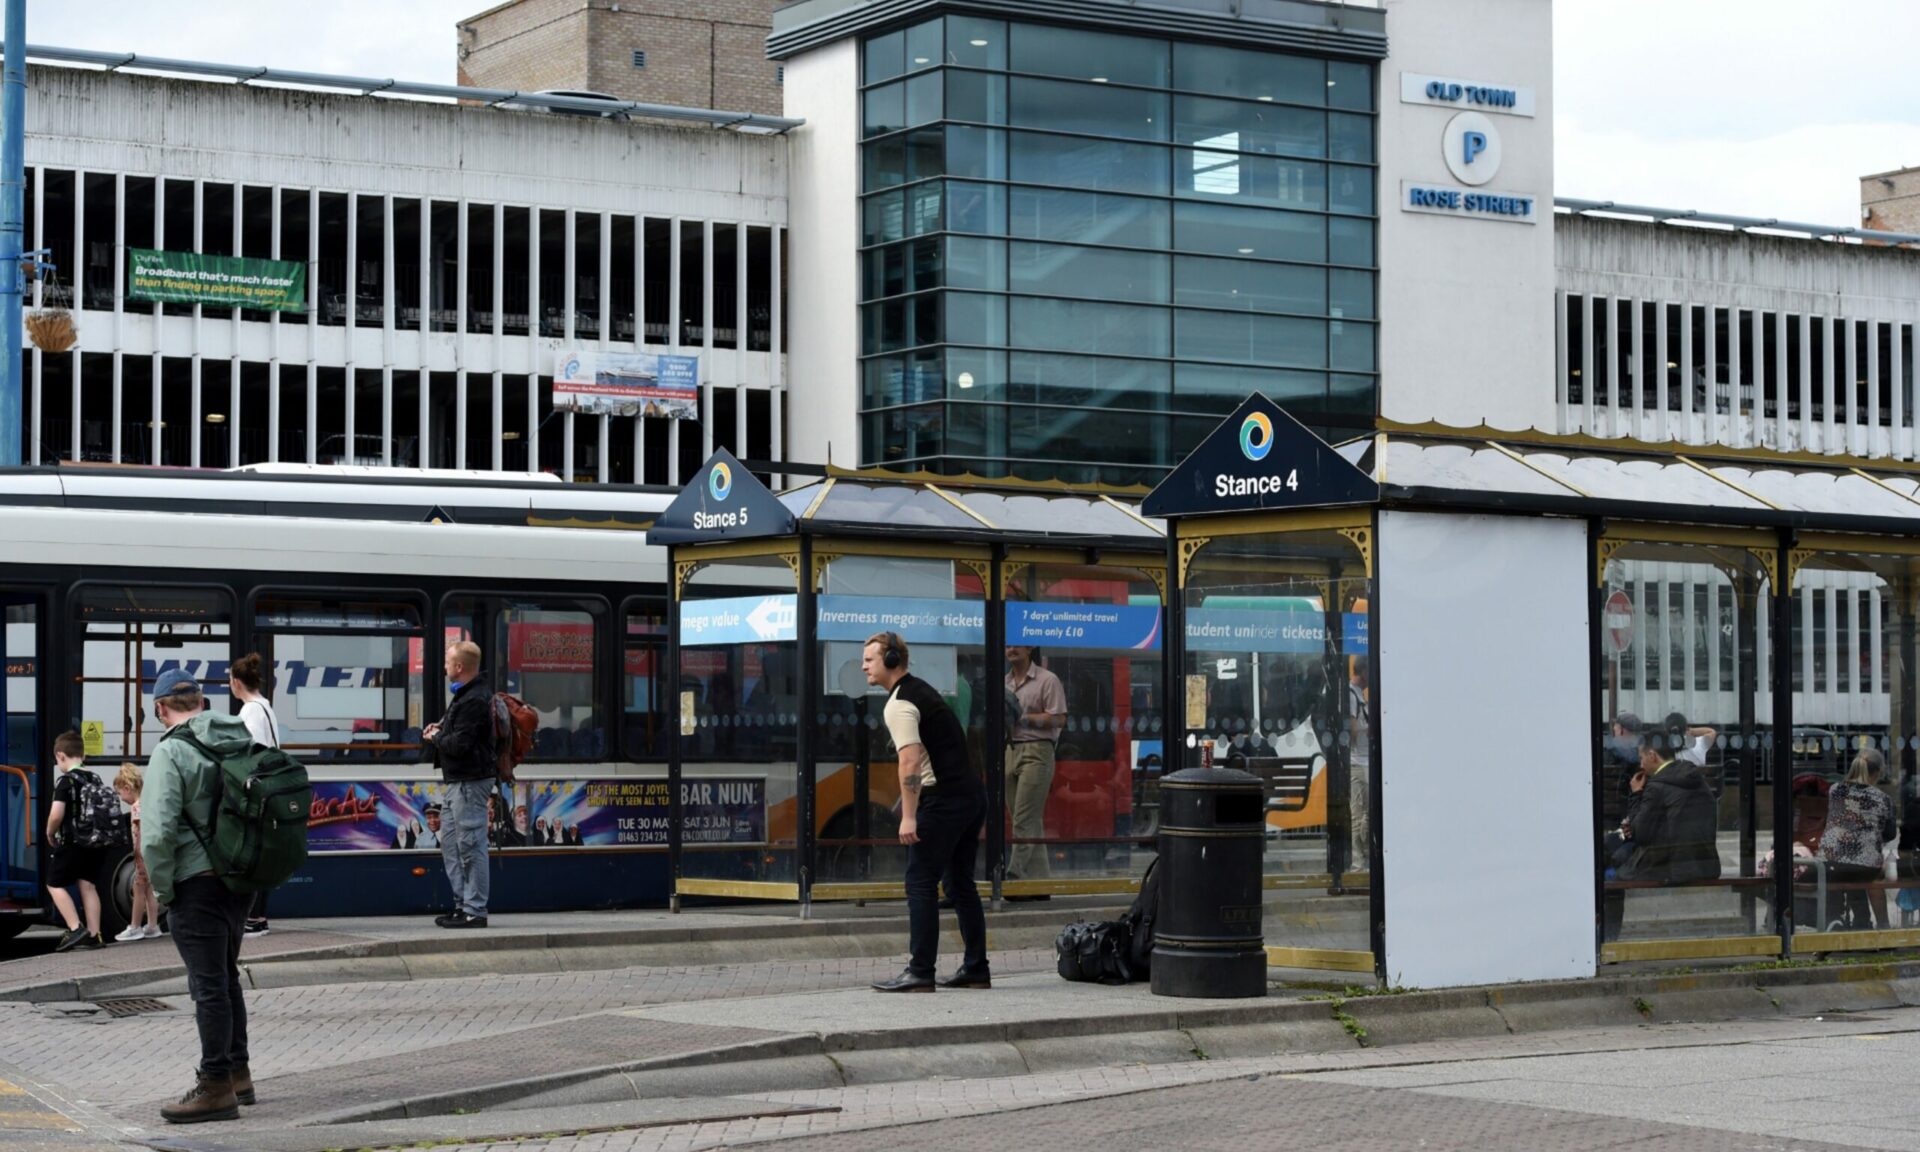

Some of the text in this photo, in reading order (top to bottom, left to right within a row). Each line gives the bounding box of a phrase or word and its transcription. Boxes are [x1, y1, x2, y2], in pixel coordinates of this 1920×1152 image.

[1426, 81, 1516, 108] OLD TOWN
[1463, 131, 1488, 165] P
[1410, 188, 1534, 216] ROSE STREET
[135, 266, 294, 287] Broadband that's much faster
[135, 278, 161, 288] than
[162, 279, 201, 293] finding
[203, 284, 210, 292] a
[210, 283, 251, 296] parking
[1215, 469, 1298, 497] Stance 4
[693, 507, 748, 530] Stance 5
[681, 610, 740, 633] mega value
[818, 607, 983, 628] Inverness megarider tickets
[1023, 610, 1029, 620] 7
[1053, 612, 1092, 622] unlimited
[1094, 613, 1118, 623] travel
[1022, 626, 1084, 639] from only £10
[1282, 625, 1324, 640] tickets
[604, 784, 619, 795] THE
[621, 784, 644, 795] MOST
[680, 783, 712, 805] BAR
[587, 796, 608, 807] SHOW
[625, 796, 642, 806] SEEN
[643, 796, 656, 805] ALL
[617, 818, 635, 829] TUE
[638, 818, 651, 829] 30
[684, 815, 731, 828] SAT 3 JUN
[618, 831, 668, 843] 01463 234 234
